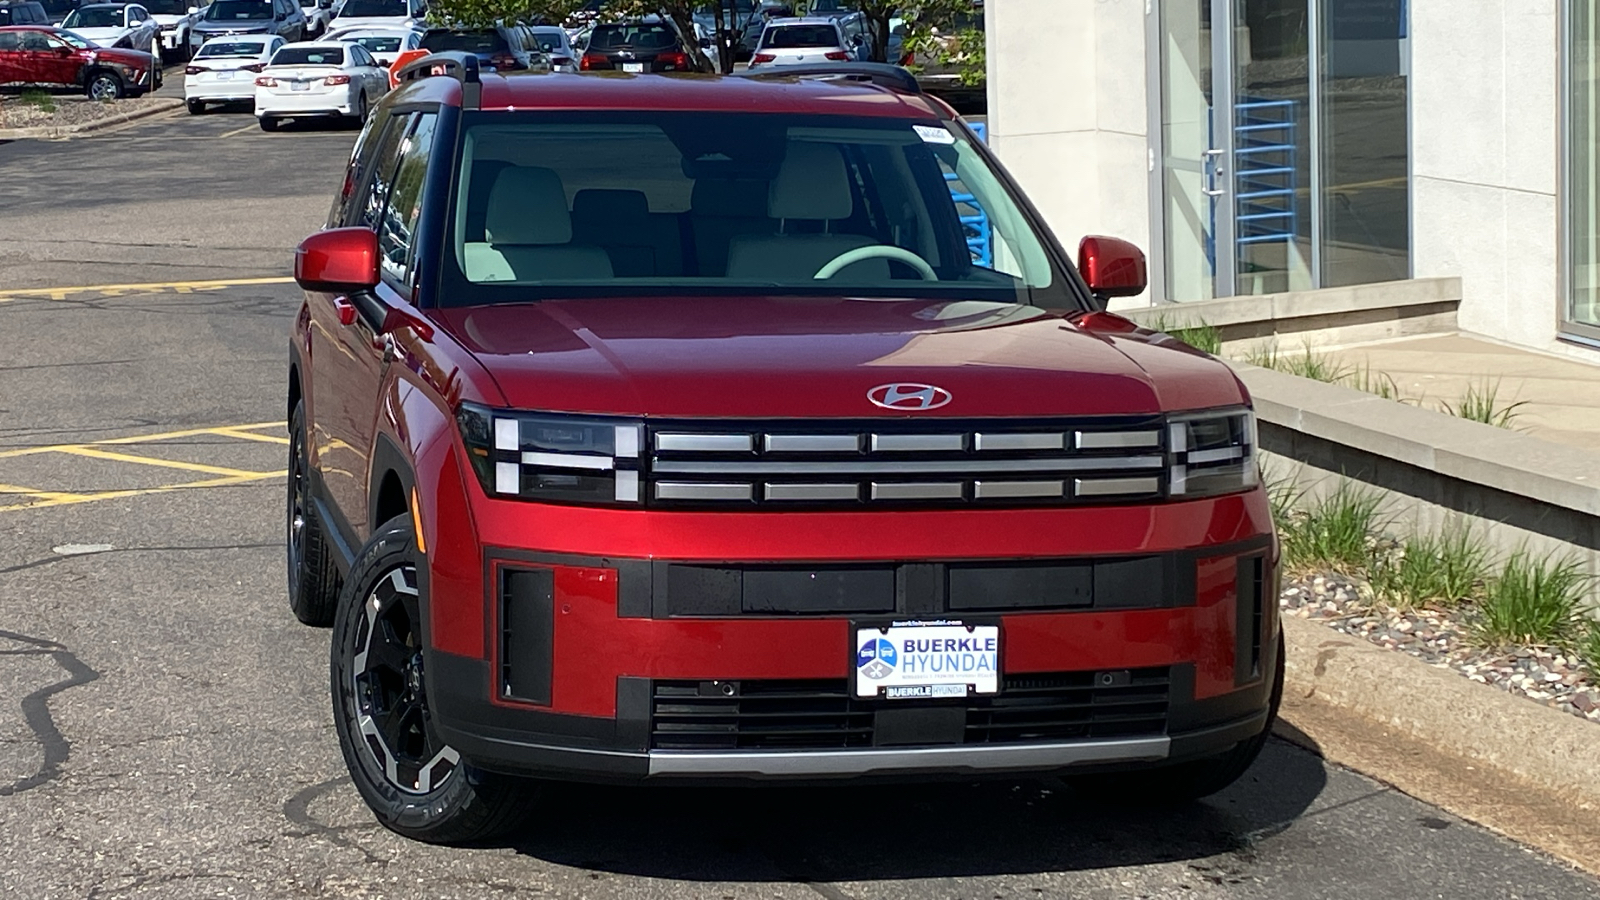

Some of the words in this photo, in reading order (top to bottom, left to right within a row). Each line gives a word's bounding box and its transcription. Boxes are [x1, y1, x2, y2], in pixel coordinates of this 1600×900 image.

[903, 638, 996, 653] BUERKLE
[902, 653, 997, 673] HYUNDAI
[888, 686, 932, 697] BUERKLE
[933, 686, 965, 695] HYUNDAI
